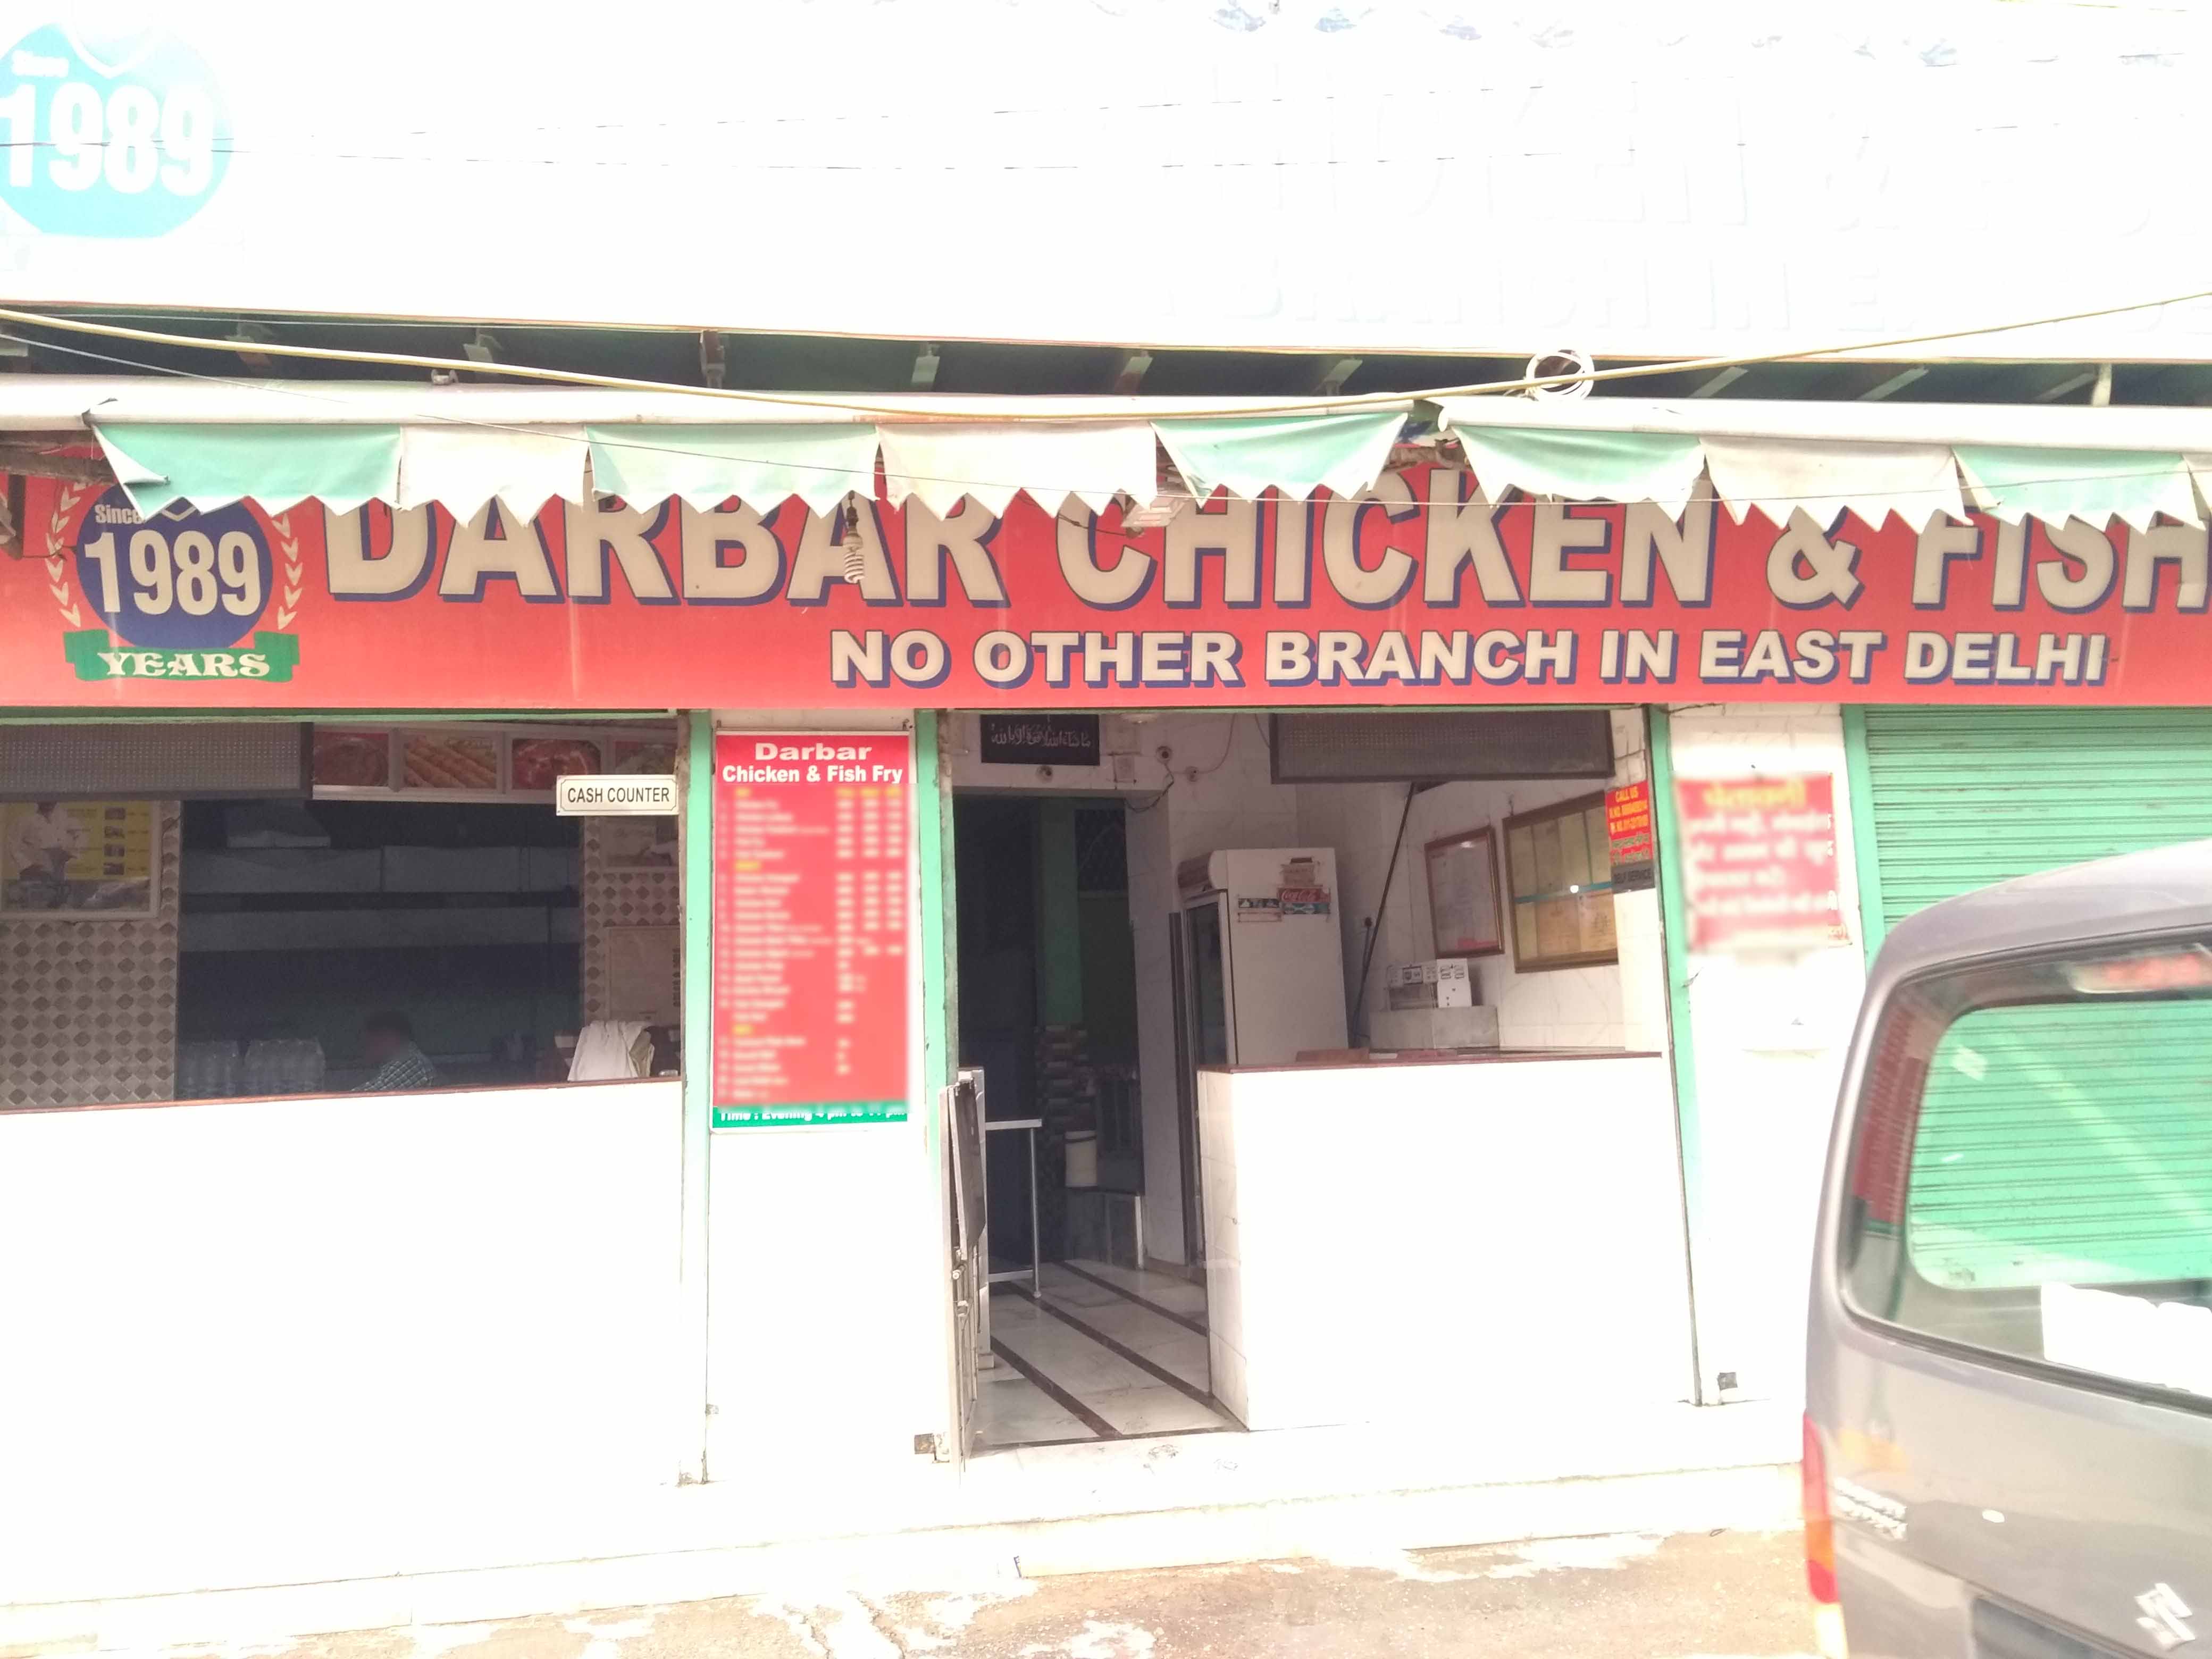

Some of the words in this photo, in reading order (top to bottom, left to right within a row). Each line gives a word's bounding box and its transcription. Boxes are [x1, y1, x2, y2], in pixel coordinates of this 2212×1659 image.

[0, 82, 214, 196] 1989
[94, 504, 145, 524] Since
[324, 492, 1011, 607] DARBAR
[1056, 468, 1717, 611] CHICKEN
[1766, 505, 1864, 610] &
[1912, 507, 2212, 614] FISH
[84, 530, 261, 616] 1989
[97, 652, 270, 677] YEARS
[831, 630, 952, 689] NO
[973, 630, 1245, 689] OTHER
[1265, 630, 1578, 687] BRANCH
[1599, 630, 1679, 685] IN
[1699, 630, 1888, 685] EAST
[1904, 631, 2108, 686] DELHI
[755, 742, 872, 761] Darbar
[723, 765, 800, 783] Chicken
[806, 766, 821, 783] &
[827, 765, 867, 783] Fish
[872, 765, 903, 784] Fry
[567, 787, 604, 803] CASH
[607, 787, 670, 803] COUNTER
